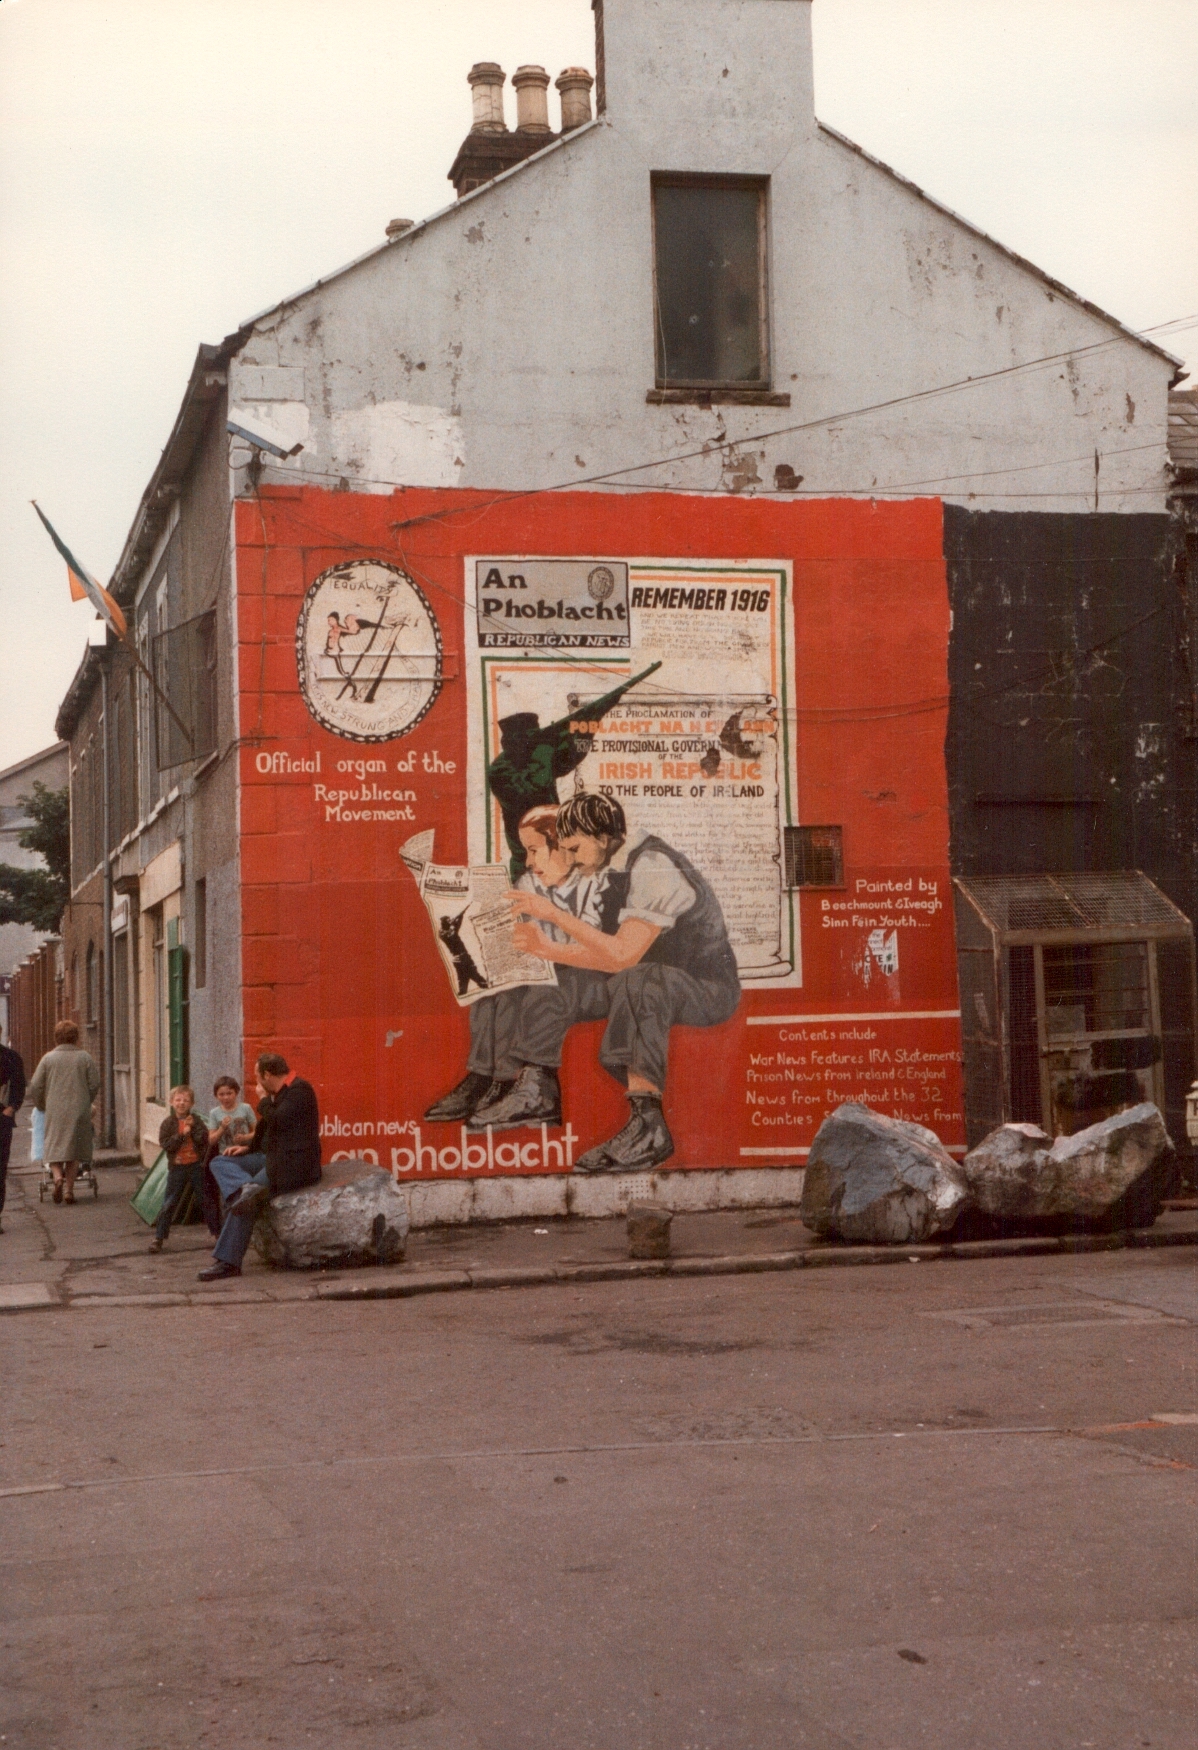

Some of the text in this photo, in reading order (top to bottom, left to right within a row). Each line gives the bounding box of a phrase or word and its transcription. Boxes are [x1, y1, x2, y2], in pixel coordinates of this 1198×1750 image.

[482, 568, 528, 589] An
[630, 587, 771, 612] REMEMBER 1916
[482, 598, 627, 621] Phoblacht
[484, 632, 630, 647] REPUBLICAN NEWS
[626, 710, 695, 718] PROCLAMATION
[700, 710, 713, 718] OF
[569, 720, 652, 734] POBLACHT
[659, 720, 685, 734] NA
[602, 739, 670, 753] PROVISIONAL
[256, 750, 456, 780] Official organ of the
[599, 762, 652, 779] IRISH
[314, 783, 416, 806] Republican
[599, 785, 613, 796] TO
[616, 785, 638, 796] THE
[643, 785, 684, 797] PEOPLE
[690, 785, 707, 797] OF
[325, 805, 416, 822] Movement
[856, 877, 938, 895] Painted by
[821, 898, 893, 911] Beechmount
[821, 915, 849, 928] Sinn
[779, 1026, 878, 1041] Contents include
[750, 1048, 961, 1066] War News Features IRA Statements
[746, 1069, 783, 1083] Prison
[784, 1068, 822, 1081] News
[906, 1066, 946, 1085] England
[745, 1086, 944, 1105] News from throughout the 32
[752, 1110, 813, 1127] Counties
[934, 1108, 962, 1120] from
[376, 1119, 417, 1136] news
[390, 1121, 579, 1181] phoblacht
